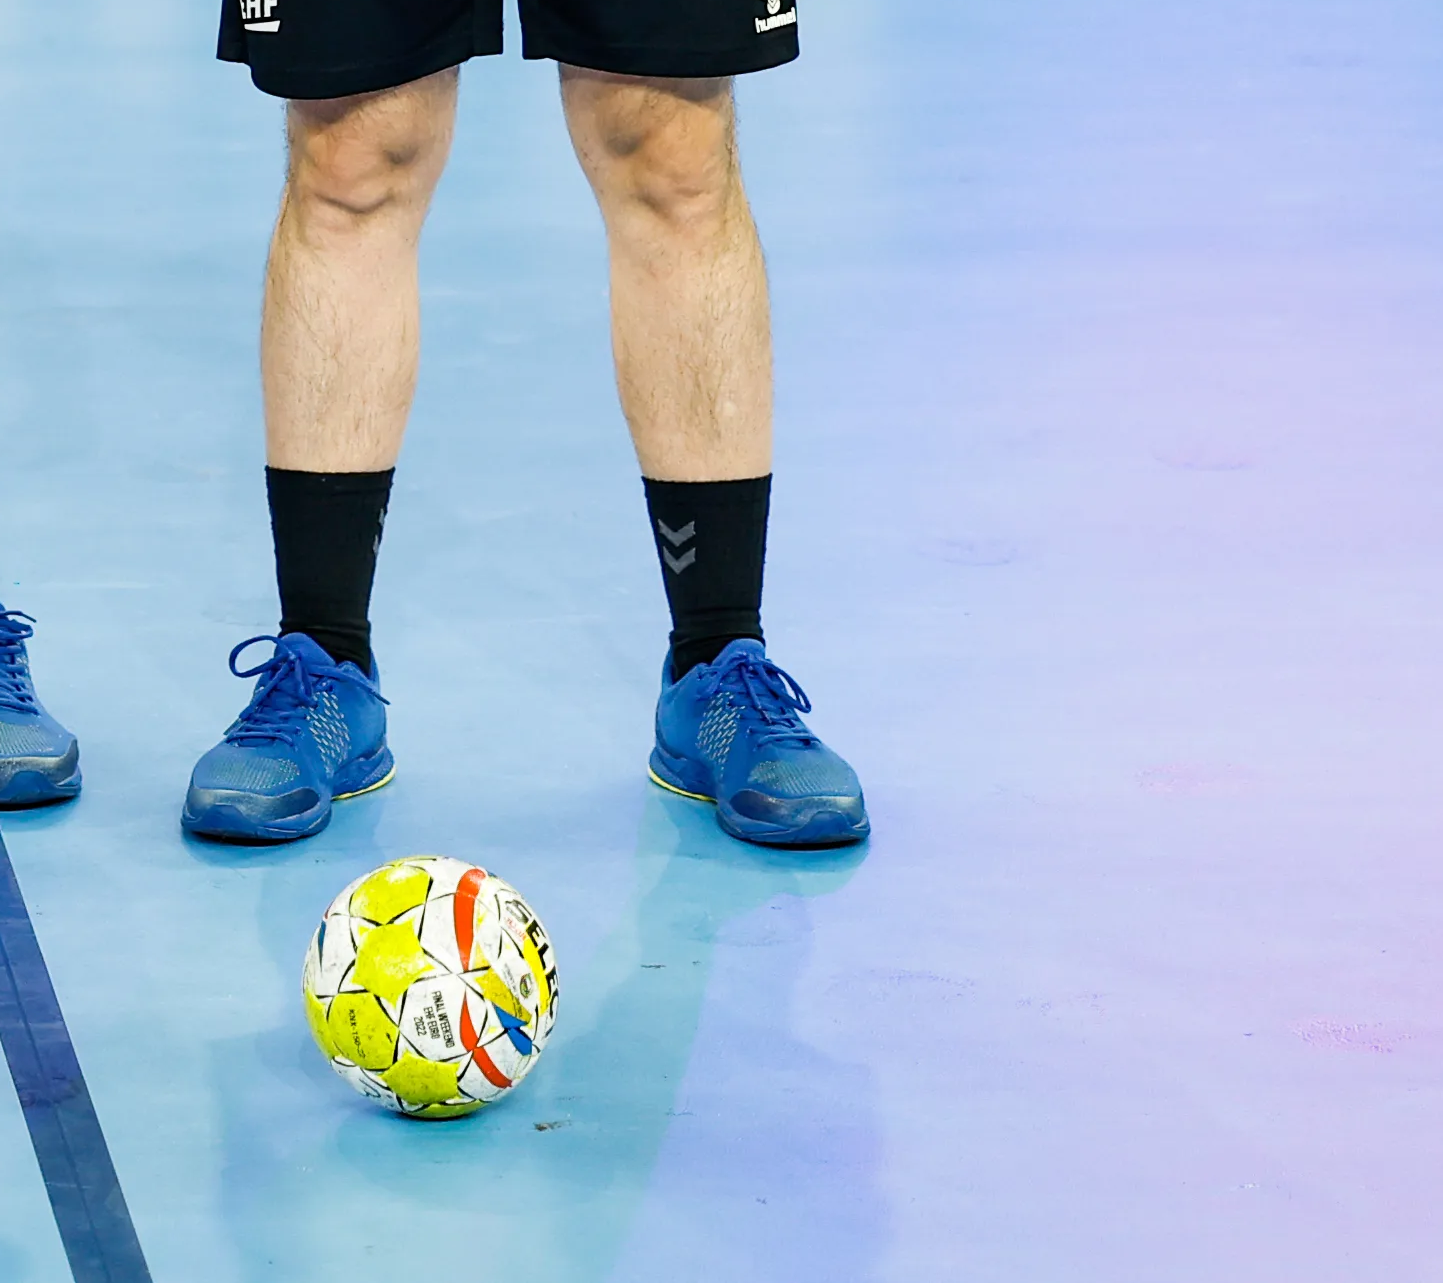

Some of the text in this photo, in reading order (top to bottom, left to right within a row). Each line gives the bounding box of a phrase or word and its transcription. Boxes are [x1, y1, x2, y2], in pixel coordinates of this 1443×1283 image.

[754, 6, 797, 34] hummel
[413, 1016, 427, 1037] 2022
[423, 1006, 441, 1040] EHF EURO
[432, 990, 456, 1049] FINAL WEEKEND
